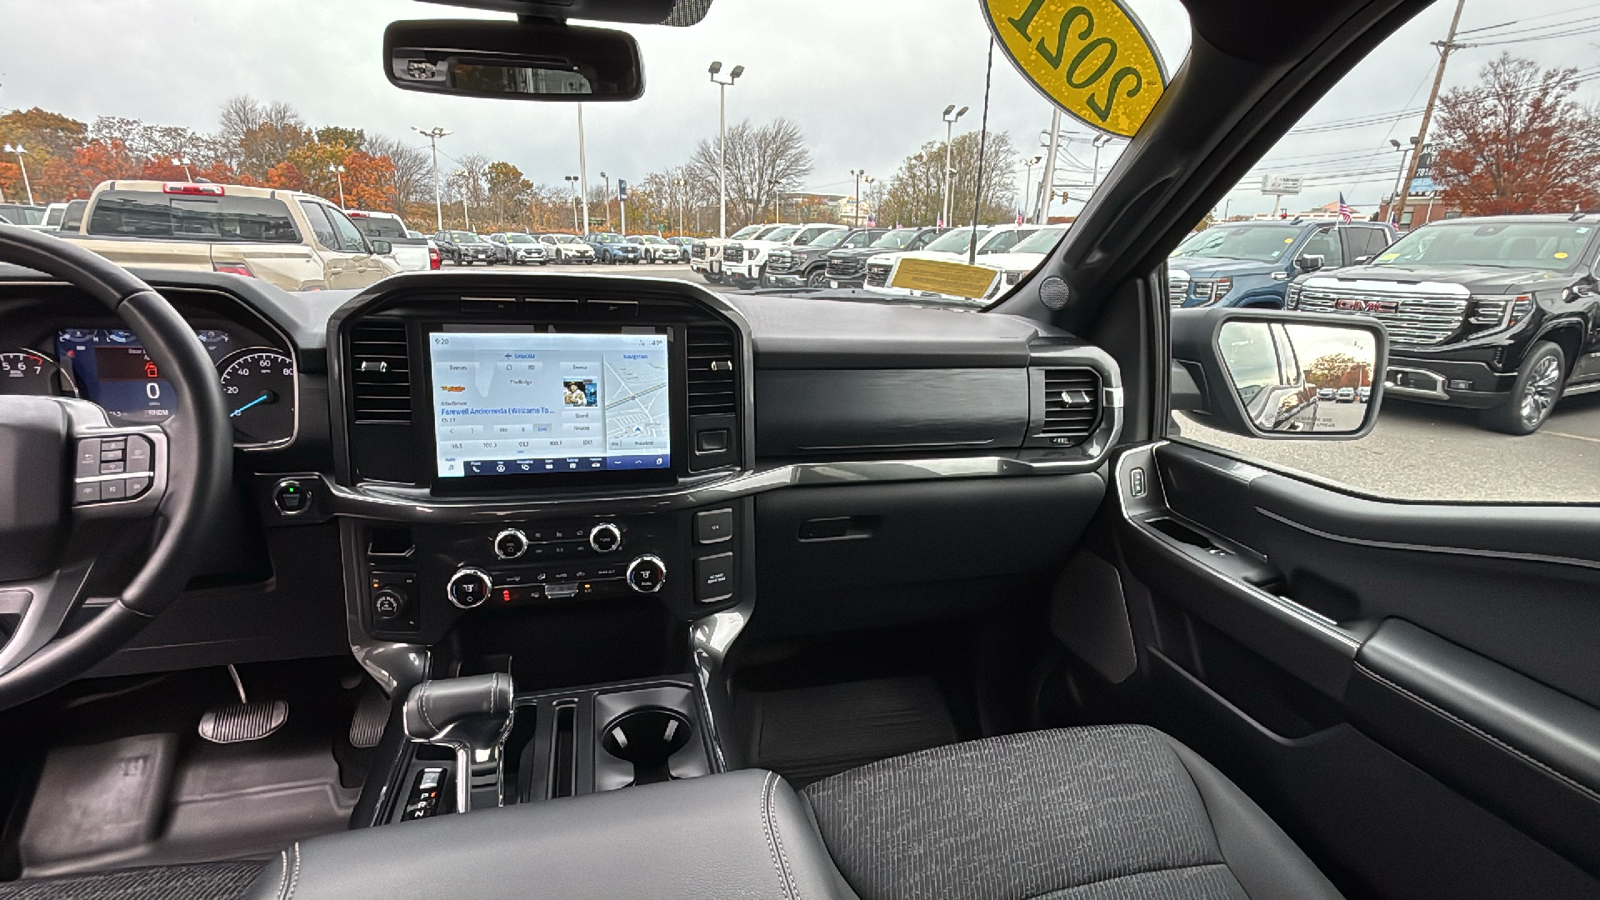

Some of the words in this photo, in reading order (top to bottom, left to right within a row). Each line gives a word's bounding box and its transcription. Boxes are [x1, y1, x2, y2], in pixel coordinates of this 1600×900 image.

[1336, 299, 1398, 313] GMC
[2, 361, 11, 371] 5
[17, 361, 26, 371] 6
[33, 366, 42, 375] 7
[237, 368, 250, 376] 40
[146, 382, 160, 399] 0
[226, 386, 239, 394] 20
[441, 407, 469, 416] Farewell
[420, 792, 429, 800] P
[414, 809, 424, 818] N
